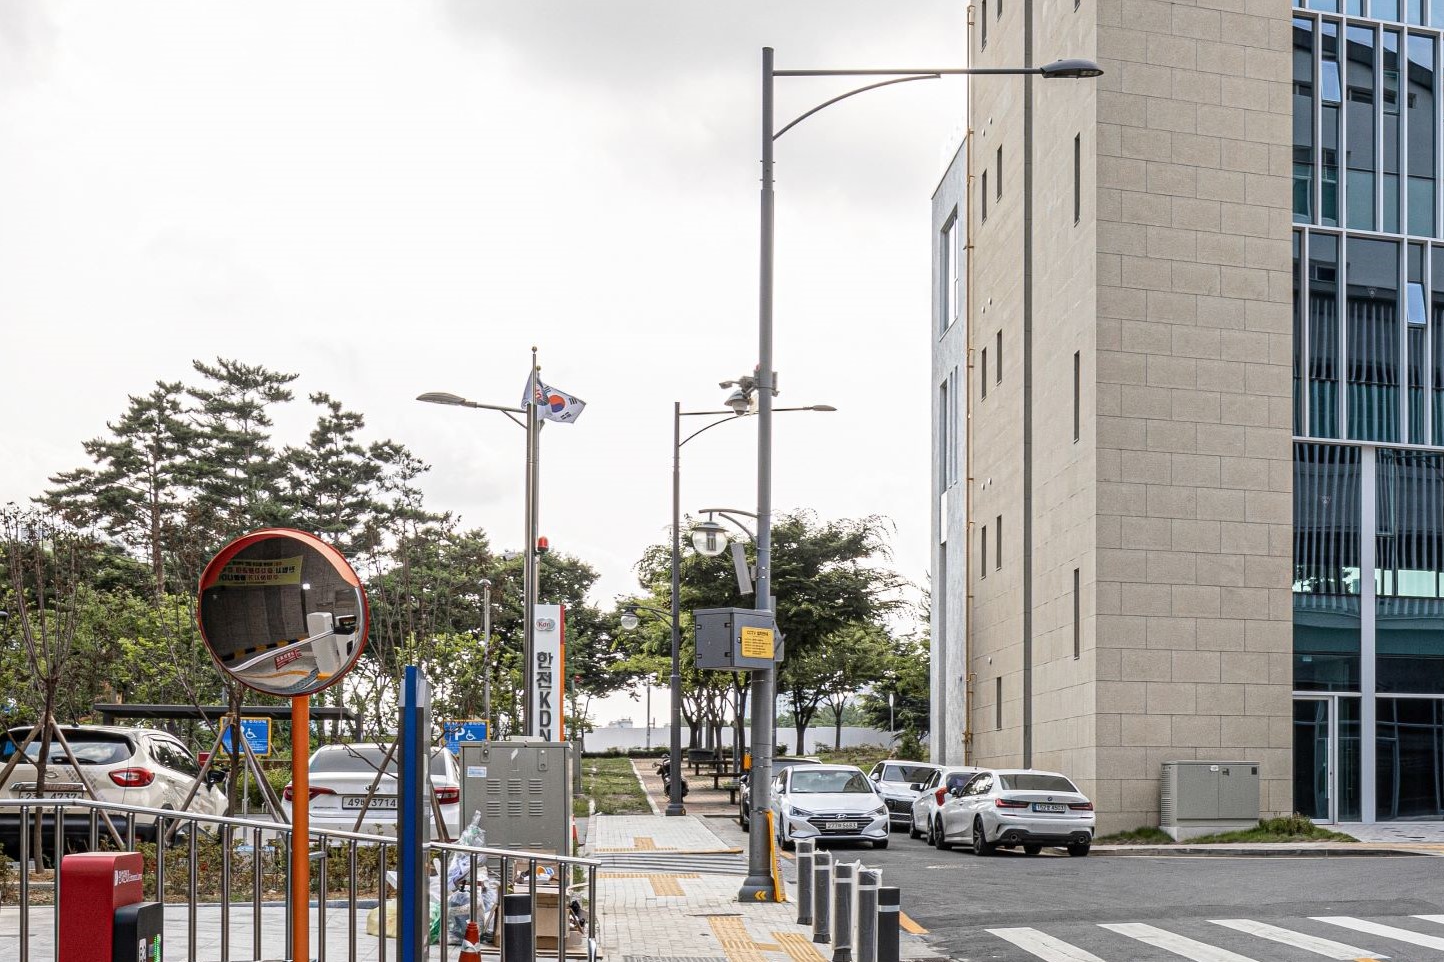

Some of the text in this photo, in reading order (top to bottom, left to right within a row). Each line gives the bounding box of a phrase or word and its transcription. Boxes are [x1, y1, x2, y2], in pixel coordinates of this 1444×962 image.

[538, 620, 551, 628] Kdn
[536, 651, 554, 742] 한전KDN
[371, 798, 396, 807] 3714
